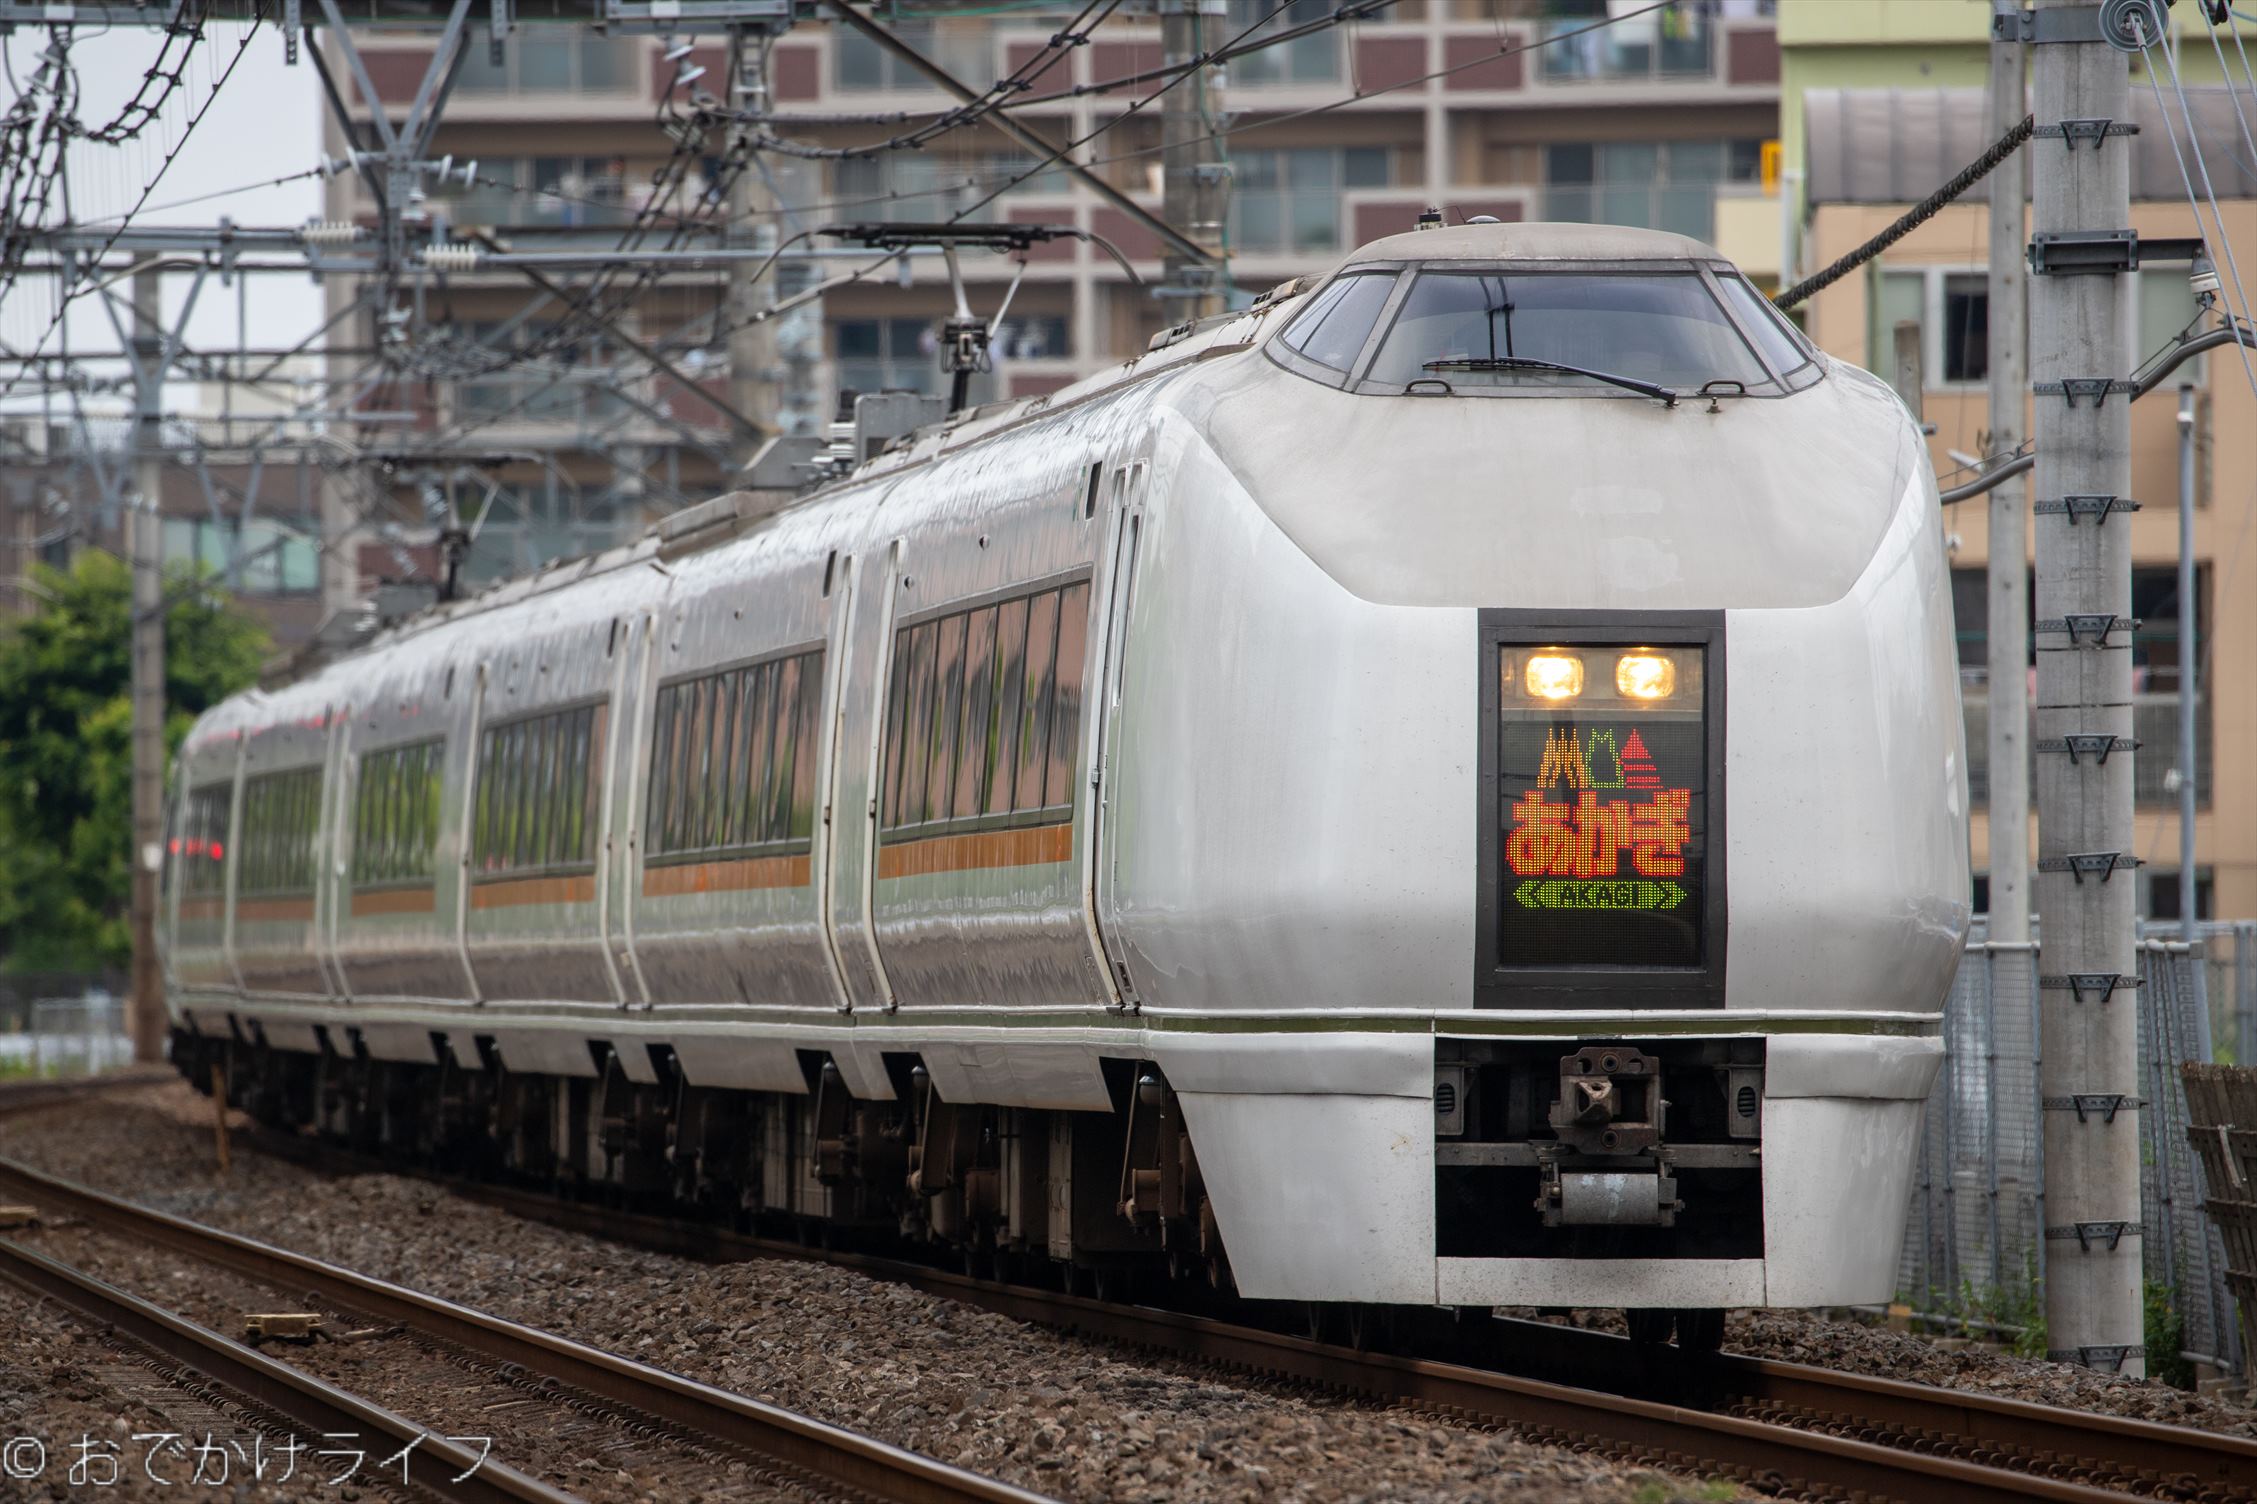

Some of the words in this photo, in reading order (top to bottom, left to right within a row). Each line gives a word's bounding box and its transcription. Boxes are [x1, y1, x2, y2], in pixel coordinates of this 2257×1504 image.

[1505, 789, 1691, 878] あかぎ
[1558, 883, 1640, 906] AKAGI
